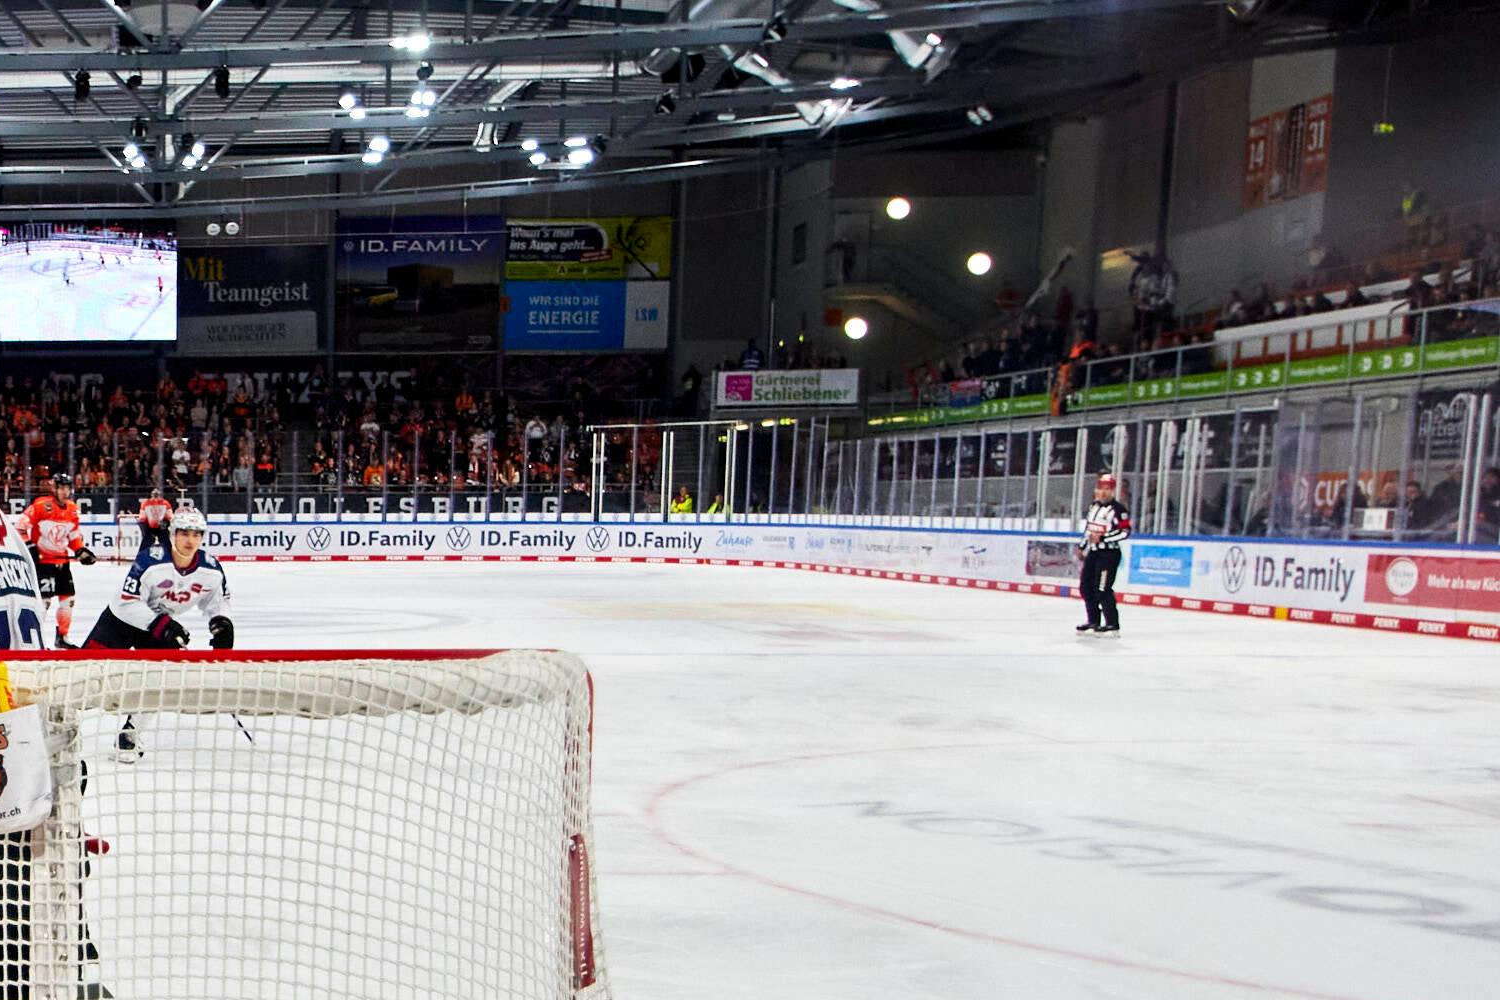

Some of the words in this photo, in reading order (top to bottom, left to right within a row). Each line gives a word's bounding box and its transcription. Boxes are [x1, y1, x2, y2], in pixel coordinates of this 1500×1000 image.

[360, 238, 489, 253] ID.FAMILY
[184, 255, 225, 281] Mit
[203, 281, 309, 307] Teamgeist
[529, 296, 551, 306] WIR
[553, 296, 580, 306] SIND
[582, 296, 600, 306] DIE
[528, 310, 600, 325] ENERGIE
[754, 372, 821, 388] Gärtnerei
[753, 386, 851, 402] Schliebener
[340, 530, 436, 551] ID.Family
[480, 530, 576, 551] ID.Family
[618, 531, 702, 554] ID.Family
[1254, 556, 1356, 602] ID.Family
[1427, 574, 1451, 589] Mehr
[1418, 621, 1446, 634] PENNY
[1467, 625, 1499, 639] PENNY
